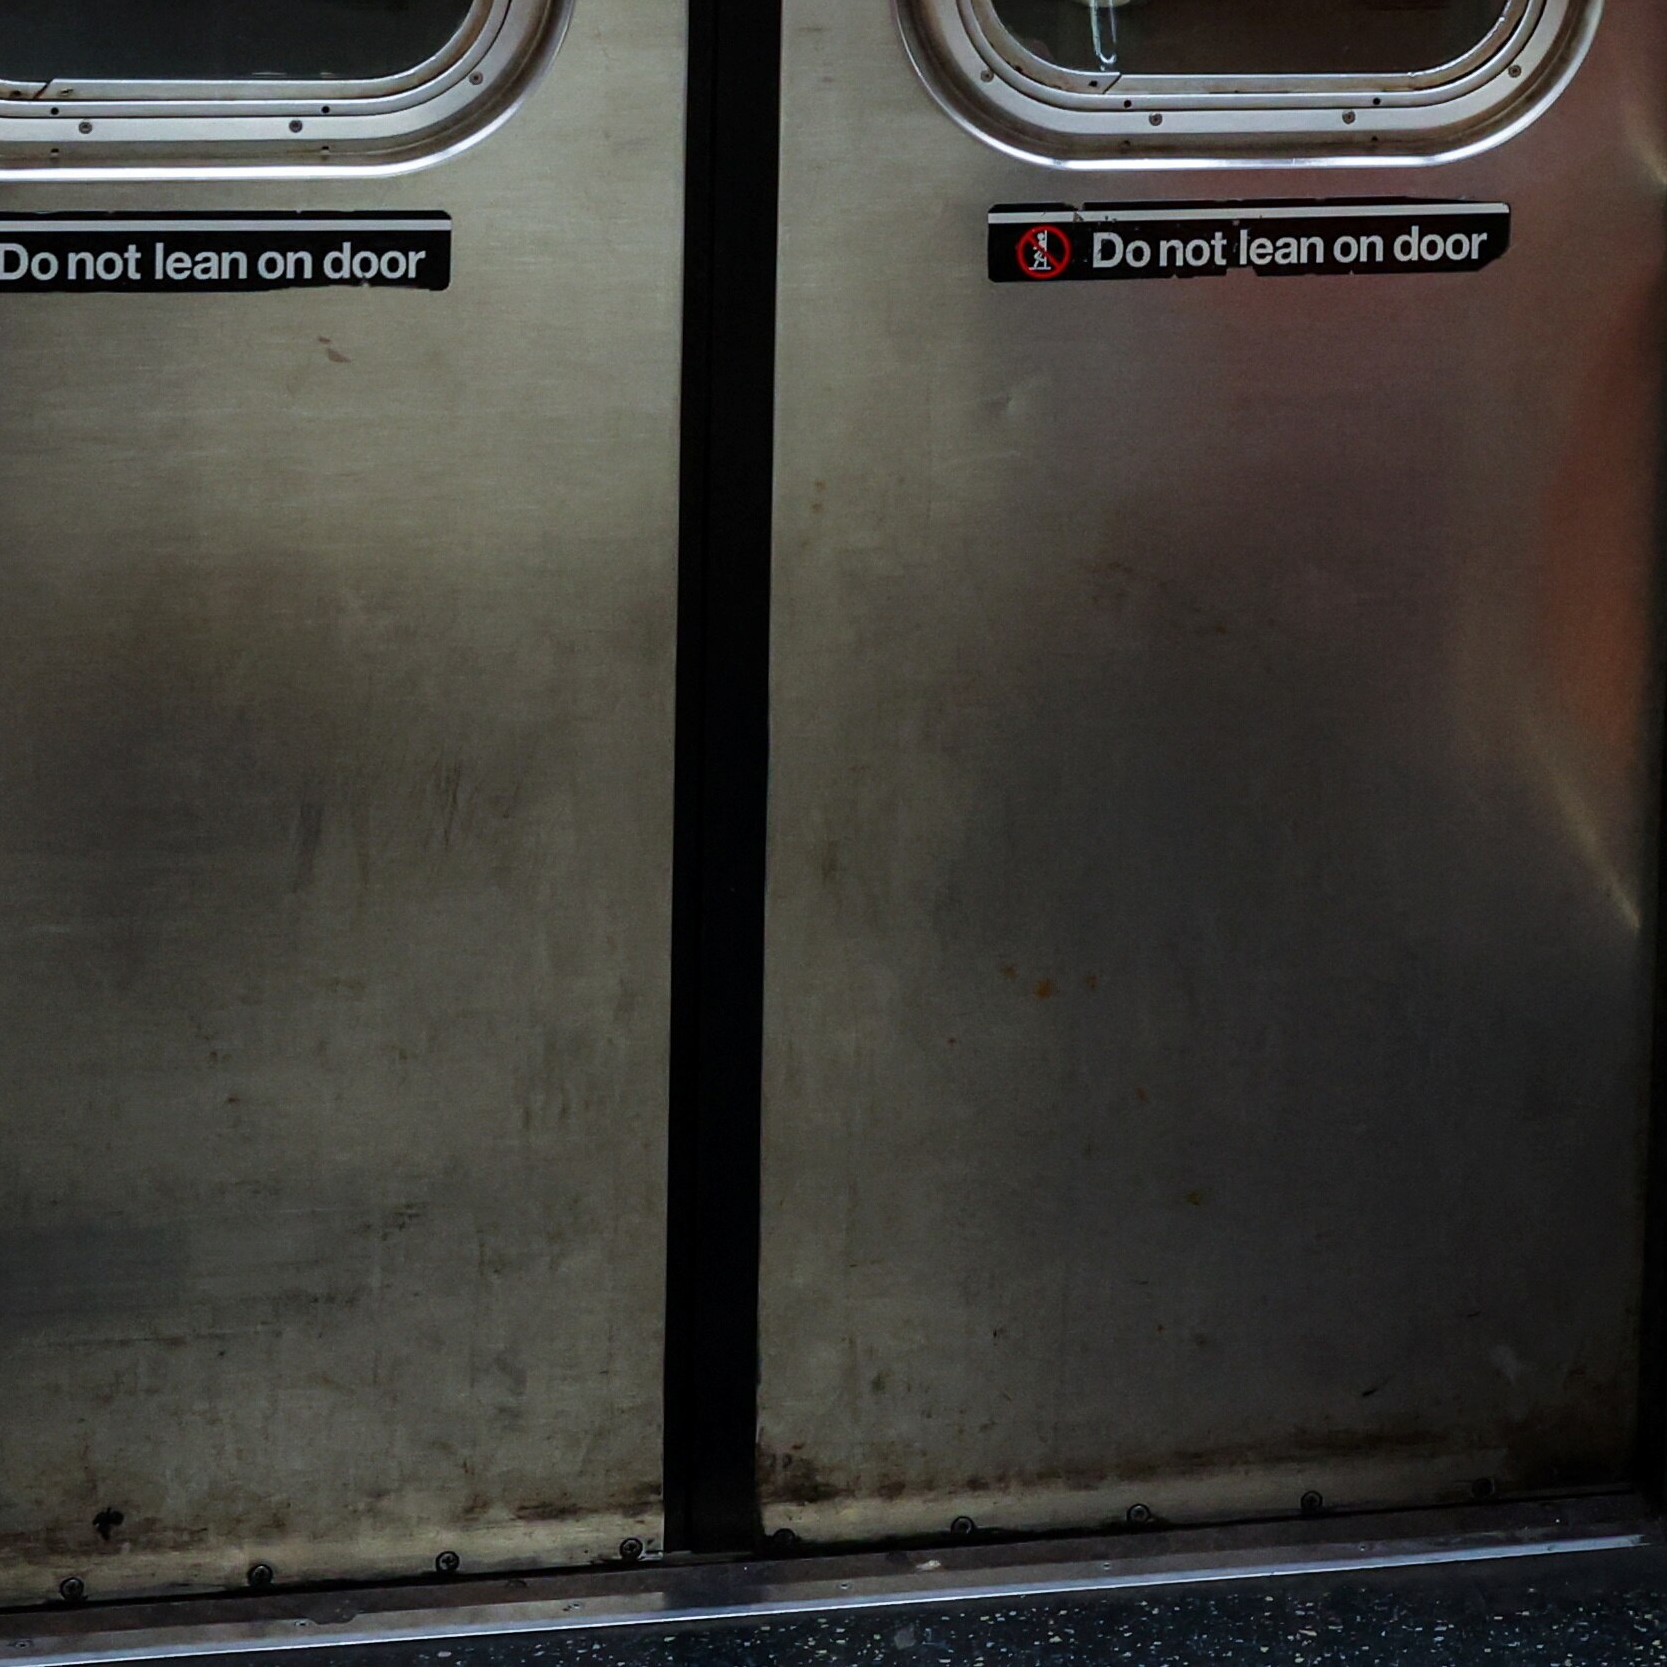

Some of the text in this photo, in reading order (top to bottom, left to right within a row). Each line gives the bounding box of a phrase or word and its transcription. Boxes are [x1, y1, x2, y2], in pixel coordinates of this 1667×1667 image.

[67, 245, 141, 280] not
[155, 243, 248, 280] lean
[257, 248, 312, 279] on
[323, 242, 426, 279] door
[1092, 226, 1488, 268] Do not lean on door
